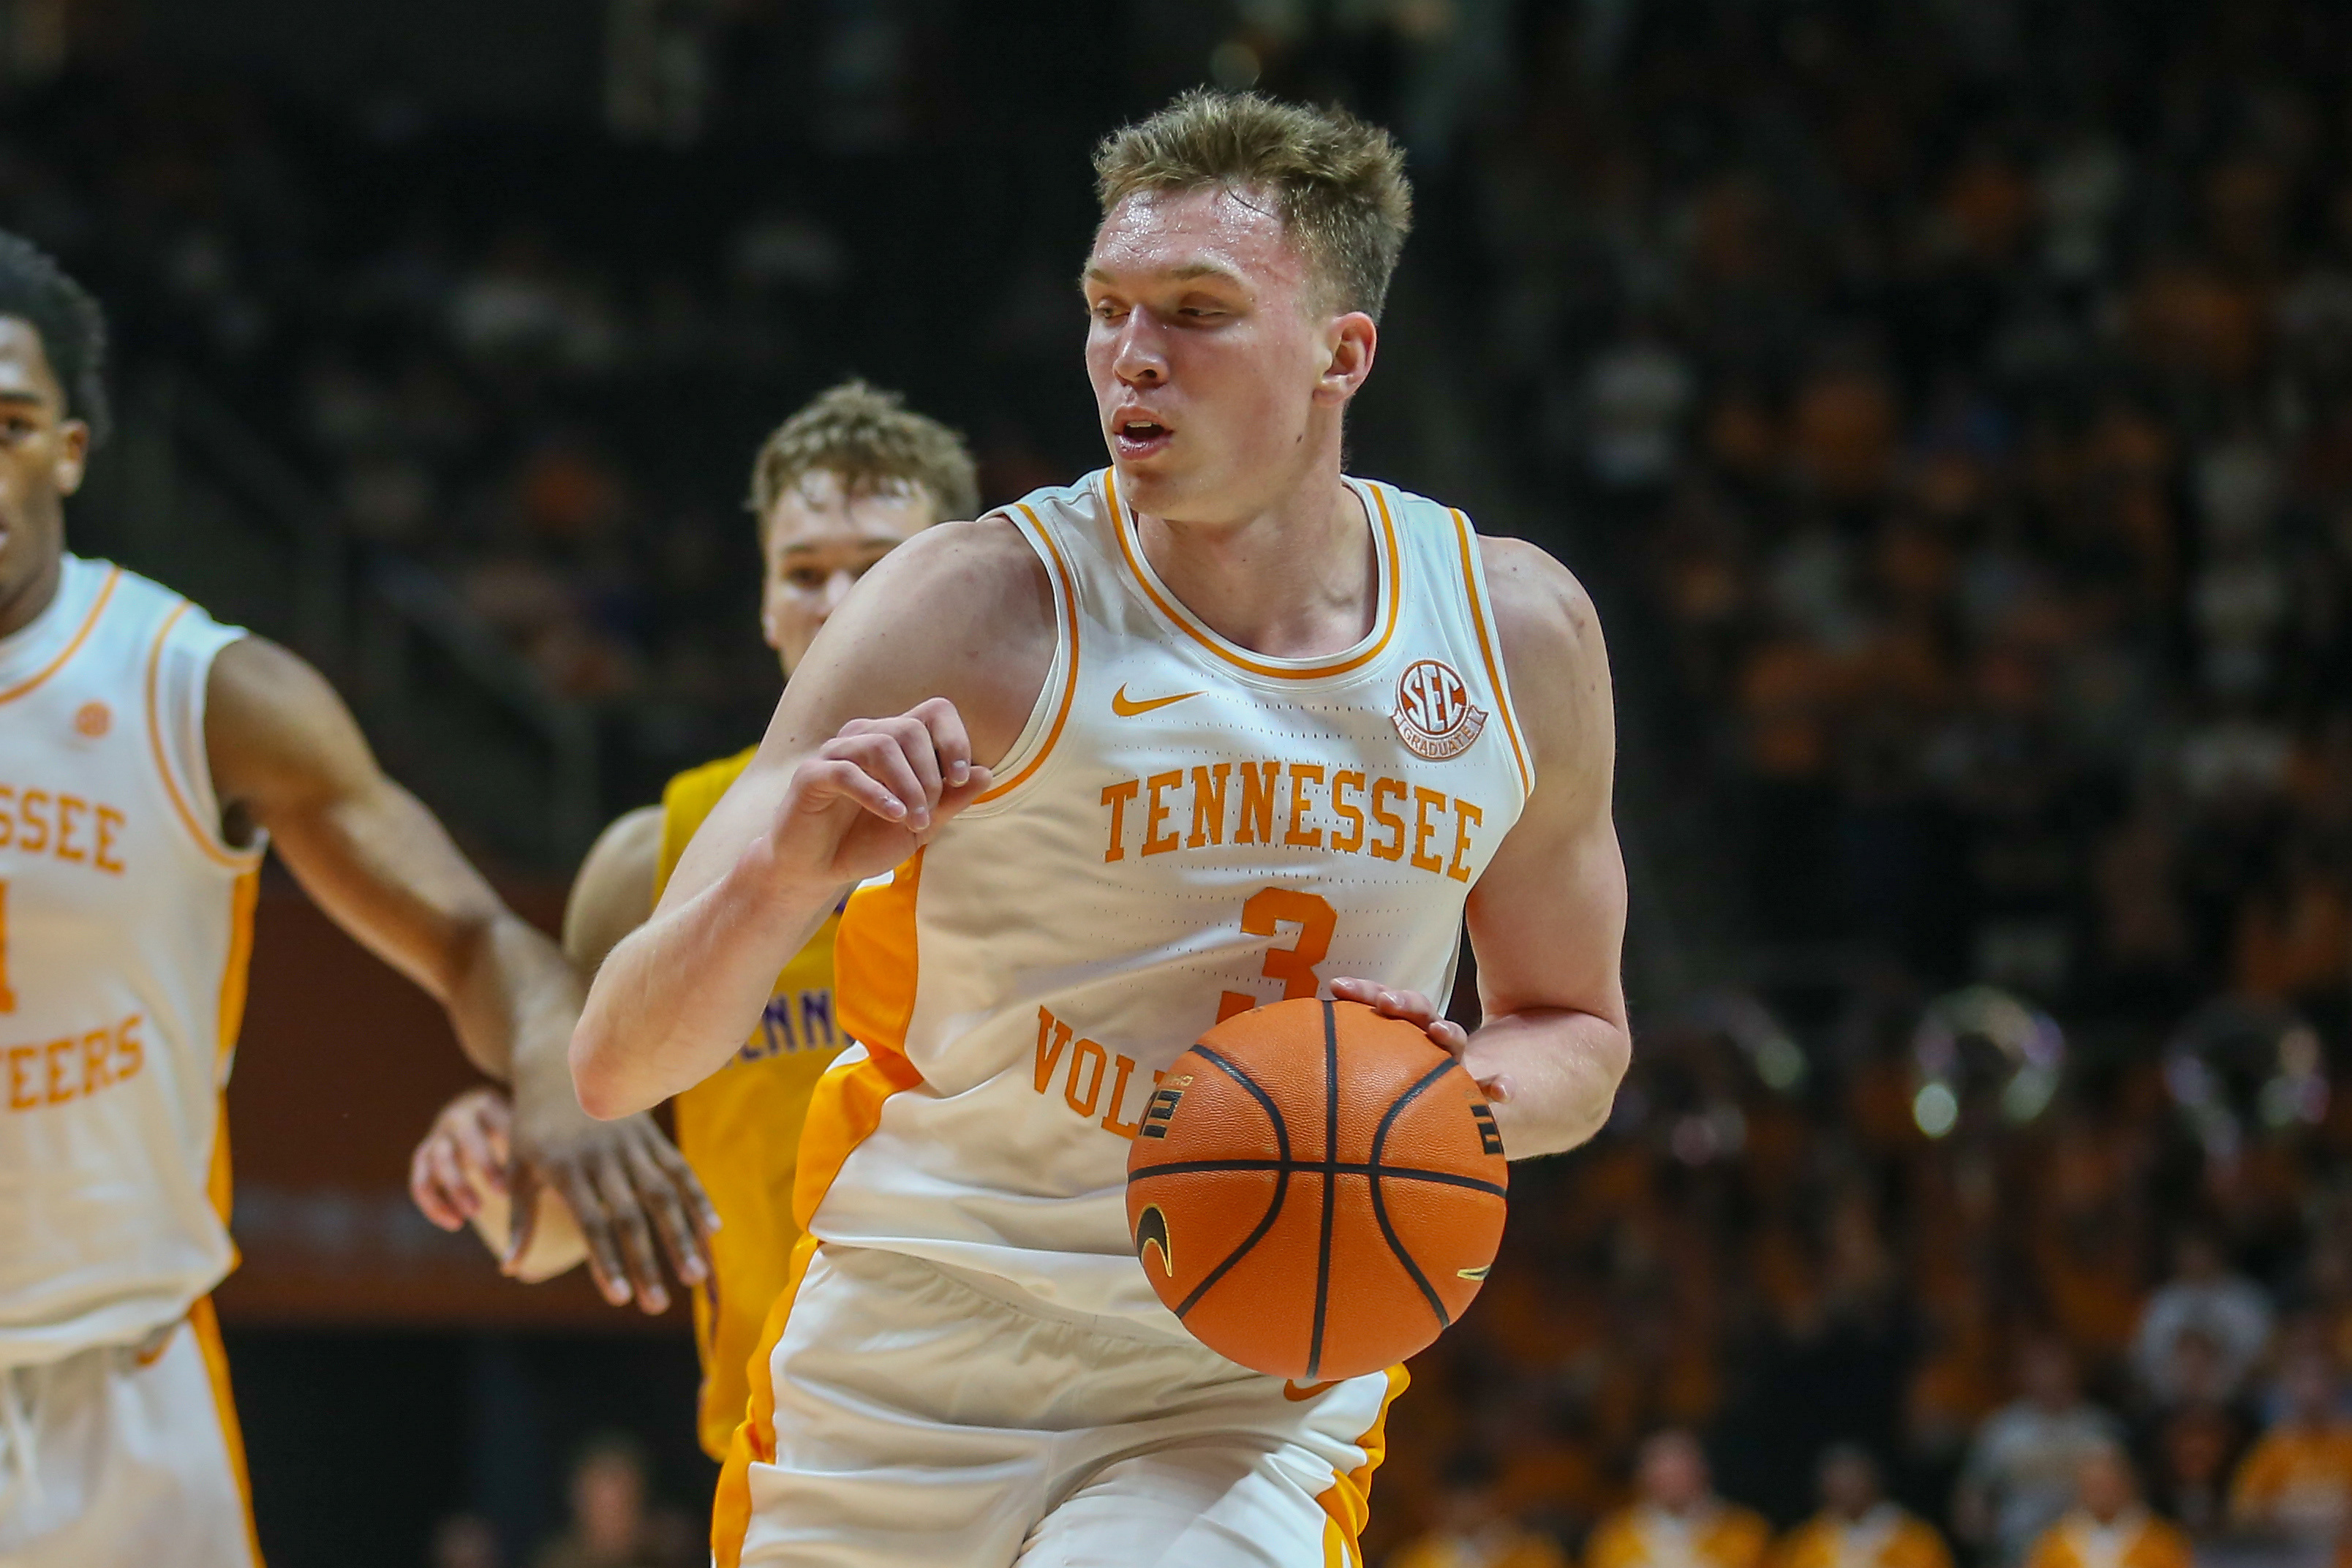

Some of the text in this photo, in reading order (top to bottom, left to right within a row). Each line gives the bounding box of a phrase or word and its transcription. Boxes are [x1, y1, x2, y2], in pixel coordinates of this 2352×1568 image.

[1403, 664, 1461, 732] SEC
[1403, 726, 1475, 756] GRADUATE
[1101, 761, 1483, 883] TENNESSEE
[1216, 886, 1338, 1025] 3
[0, 1014, 144, 1111] EERS
[1033, 1004, 1166, 1141] VOL
